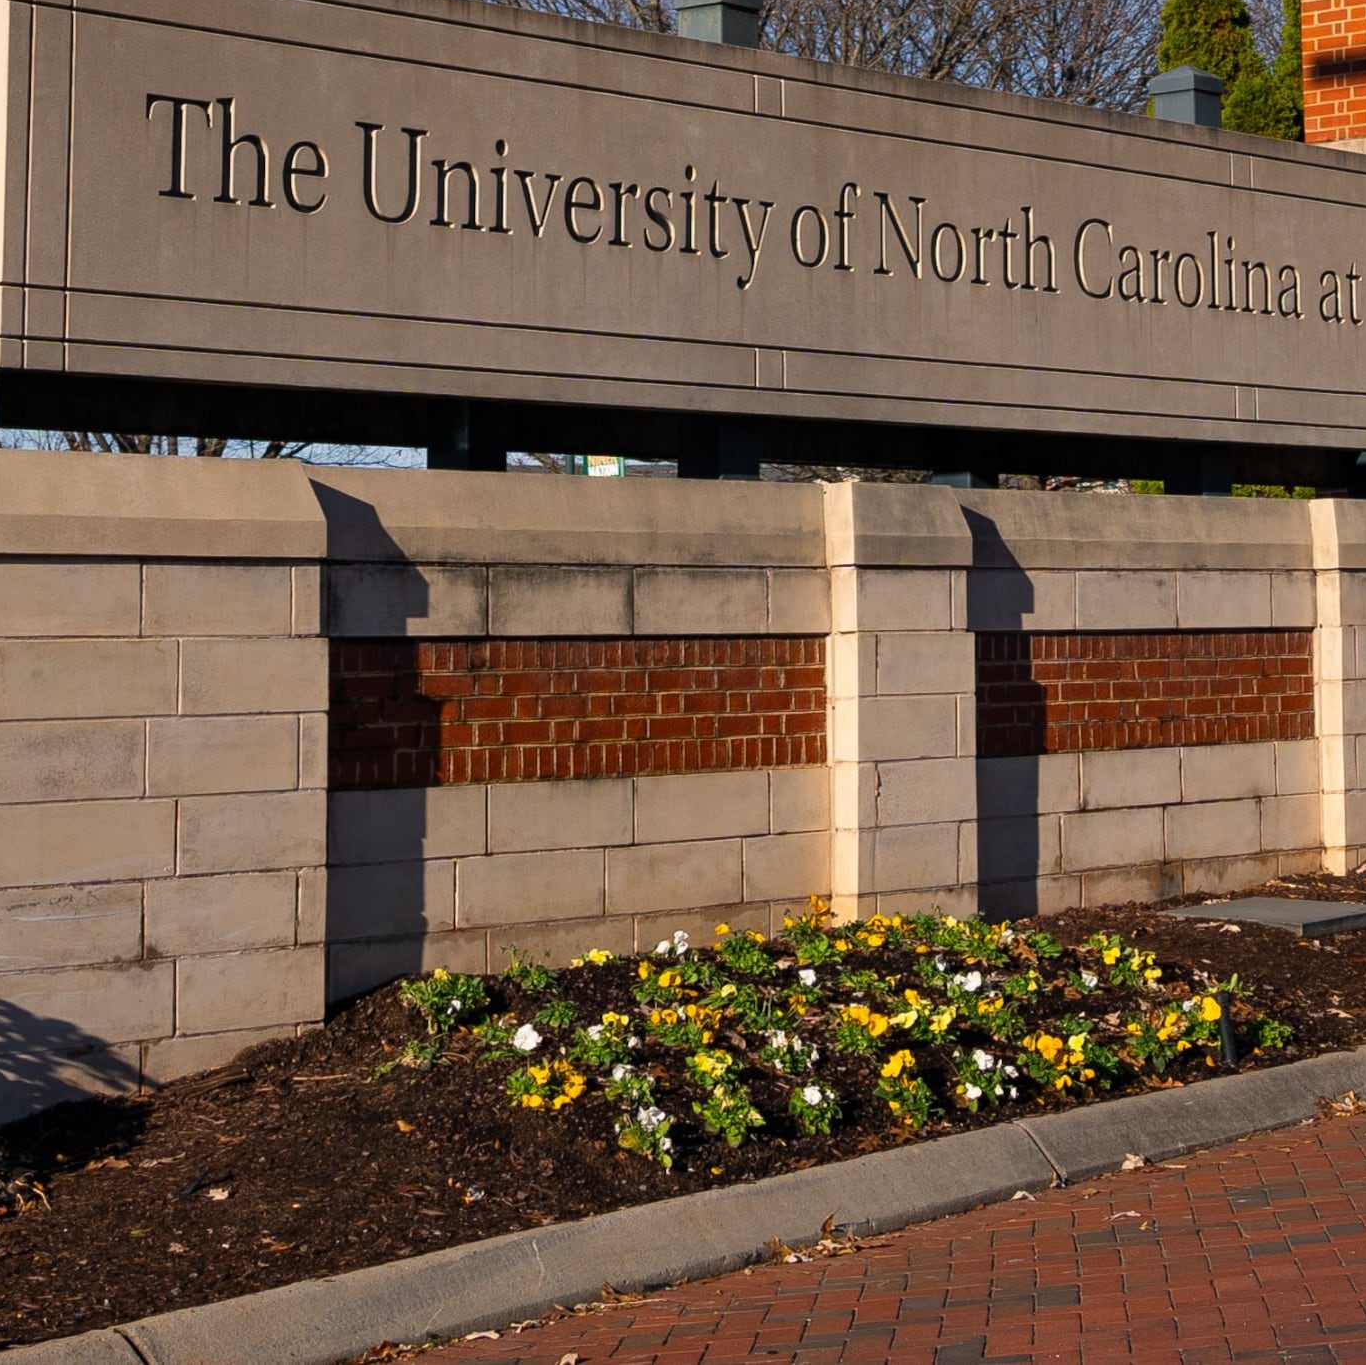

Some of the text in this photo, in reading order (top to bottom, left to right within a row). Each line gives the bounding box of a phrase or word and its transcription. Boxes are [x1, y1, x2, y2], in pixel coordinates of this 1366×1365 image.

[145, 92, 329, 216] The
[355, 120, 775, 290] University
[790, 181, 862, 272] of
[872, 191, 1061, 295] North
[1073, 217, 1304, 320] Carolina
[1318, 261, 1365, 326] at
